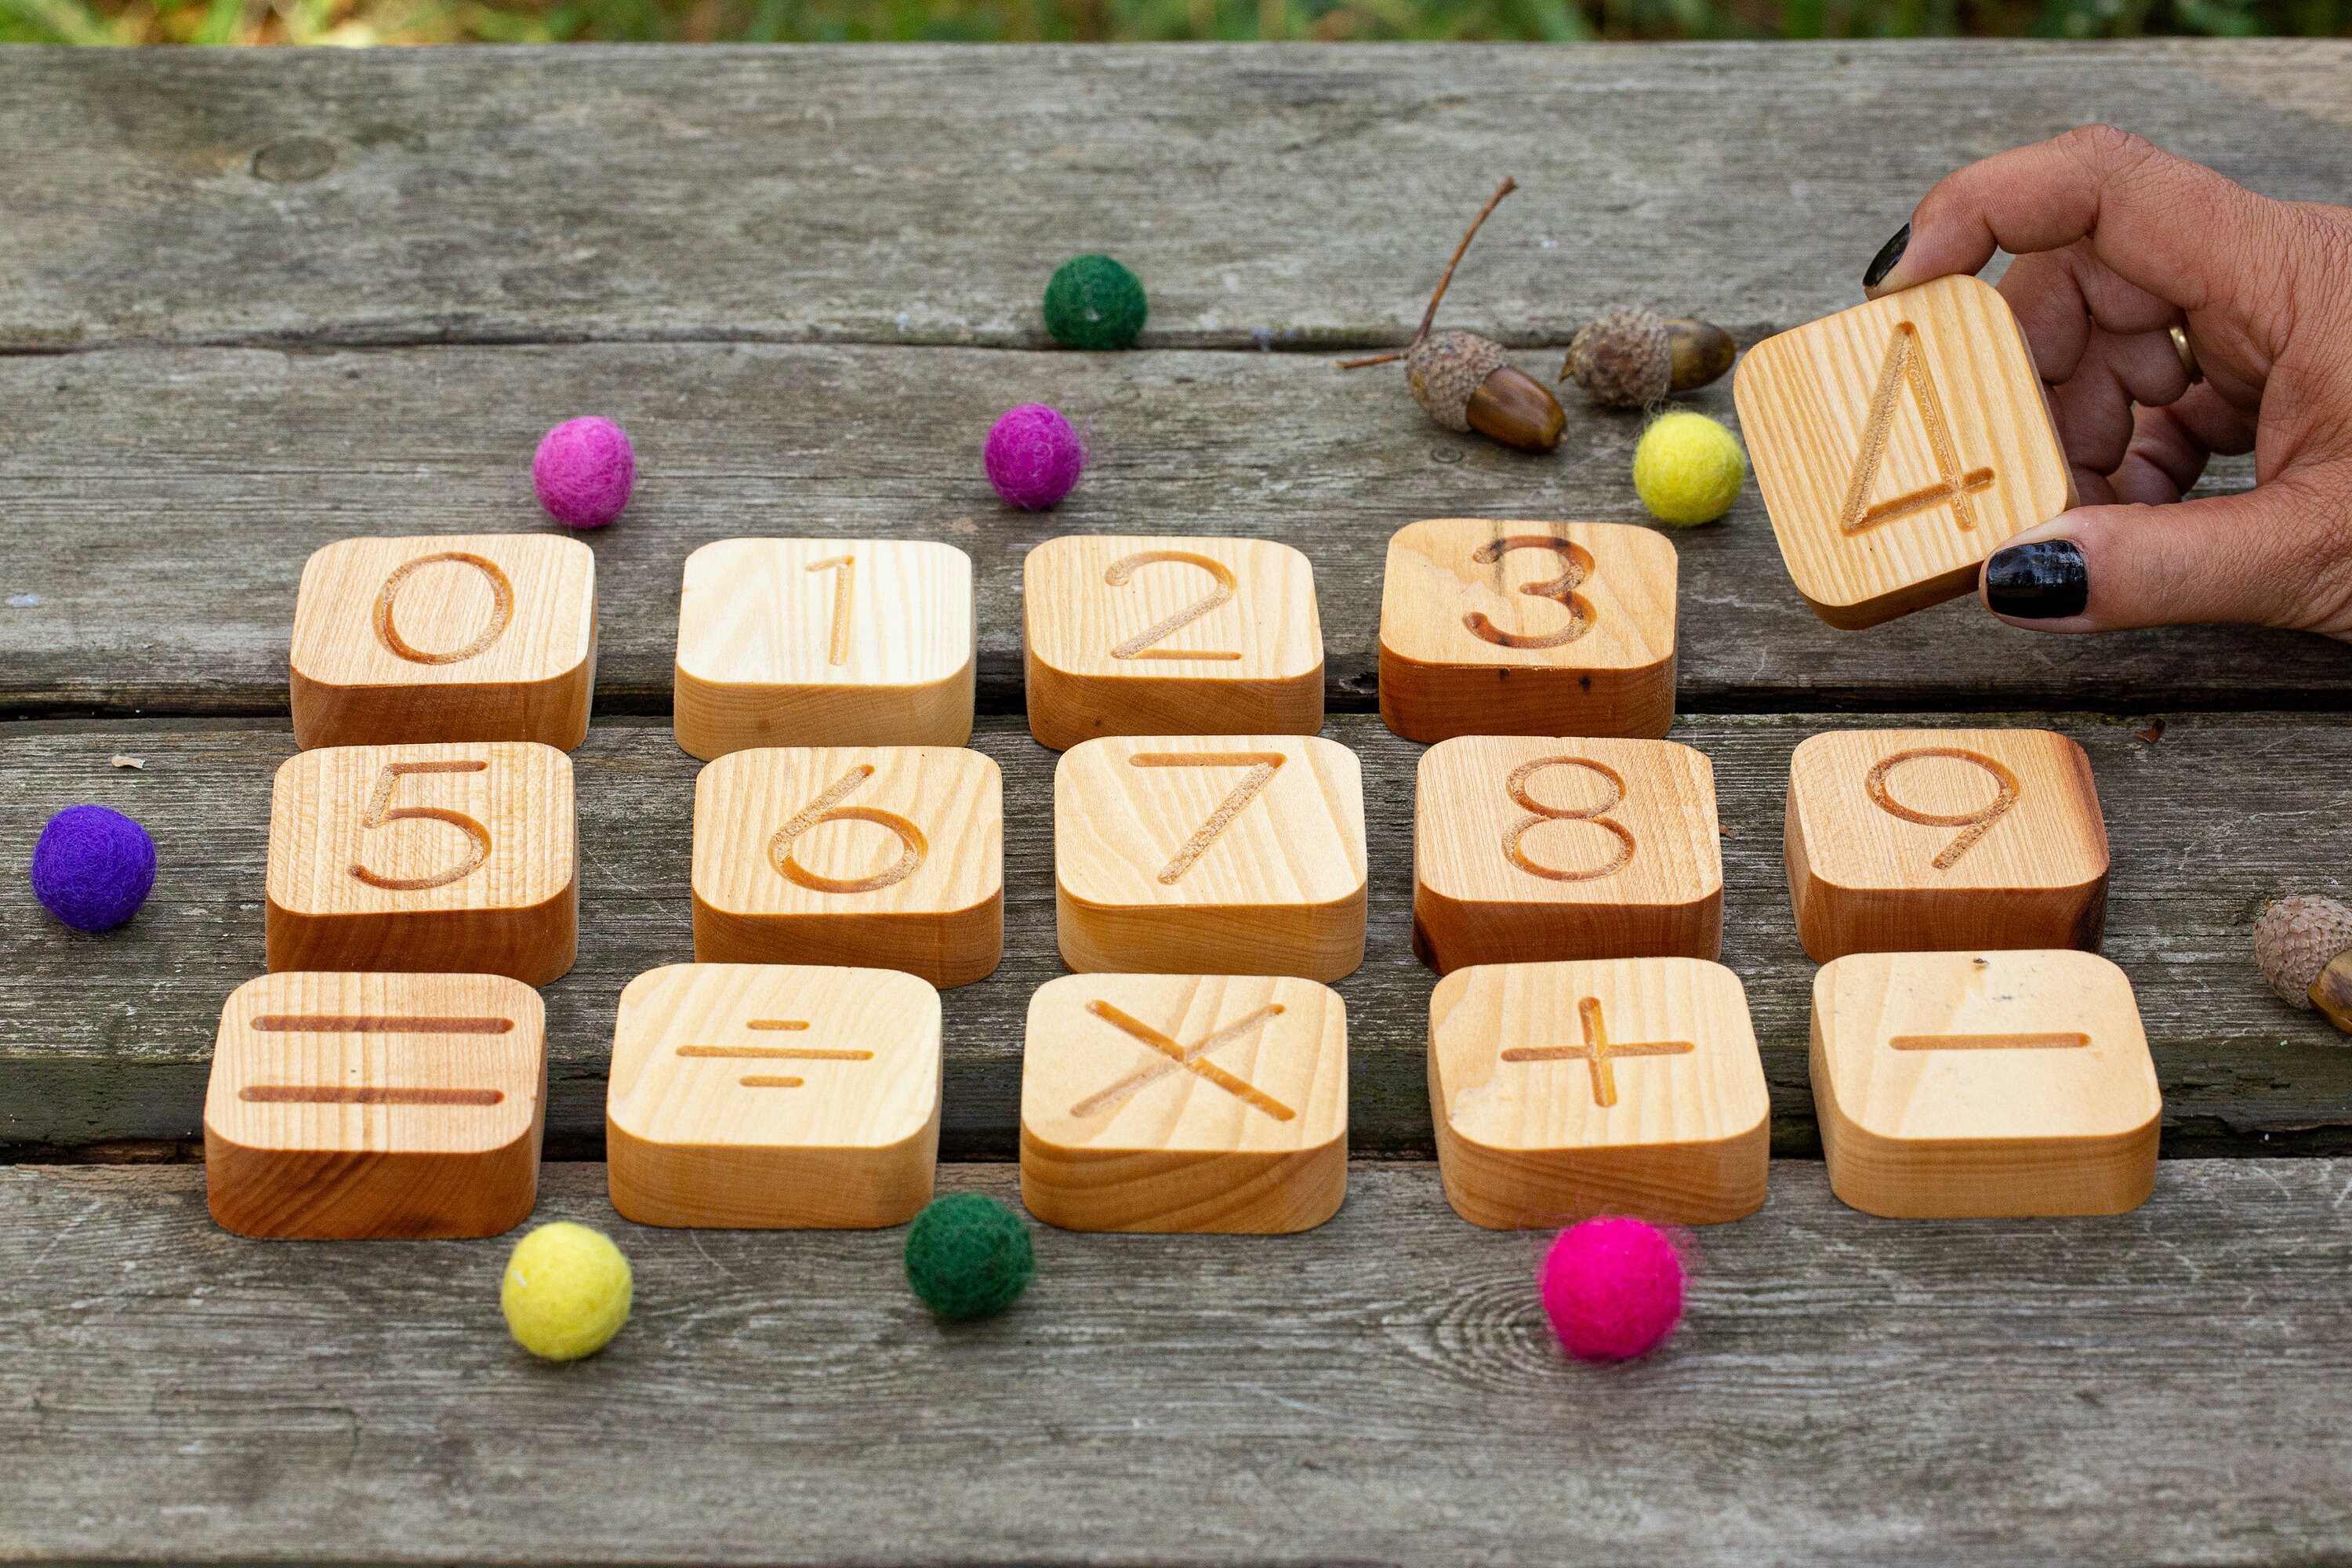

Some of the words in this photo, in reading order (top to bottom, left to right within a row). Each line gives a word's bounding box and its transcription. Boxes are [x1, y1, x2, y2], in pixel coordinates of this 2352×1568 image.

[1842, 320, 1995, 534] 4
[805, 555, 855, 665] 1
[1105, 551, 1242, 659] 2
[1463, 535, 1595, 647] 3
[350, 760, 489, 889] 5
[770, 764, 928, 891] 6
[1128, 753, 1284, 884] 7
[1502, 757, 1635, 880] 8
[1865, 748, 2016, 869] 9
